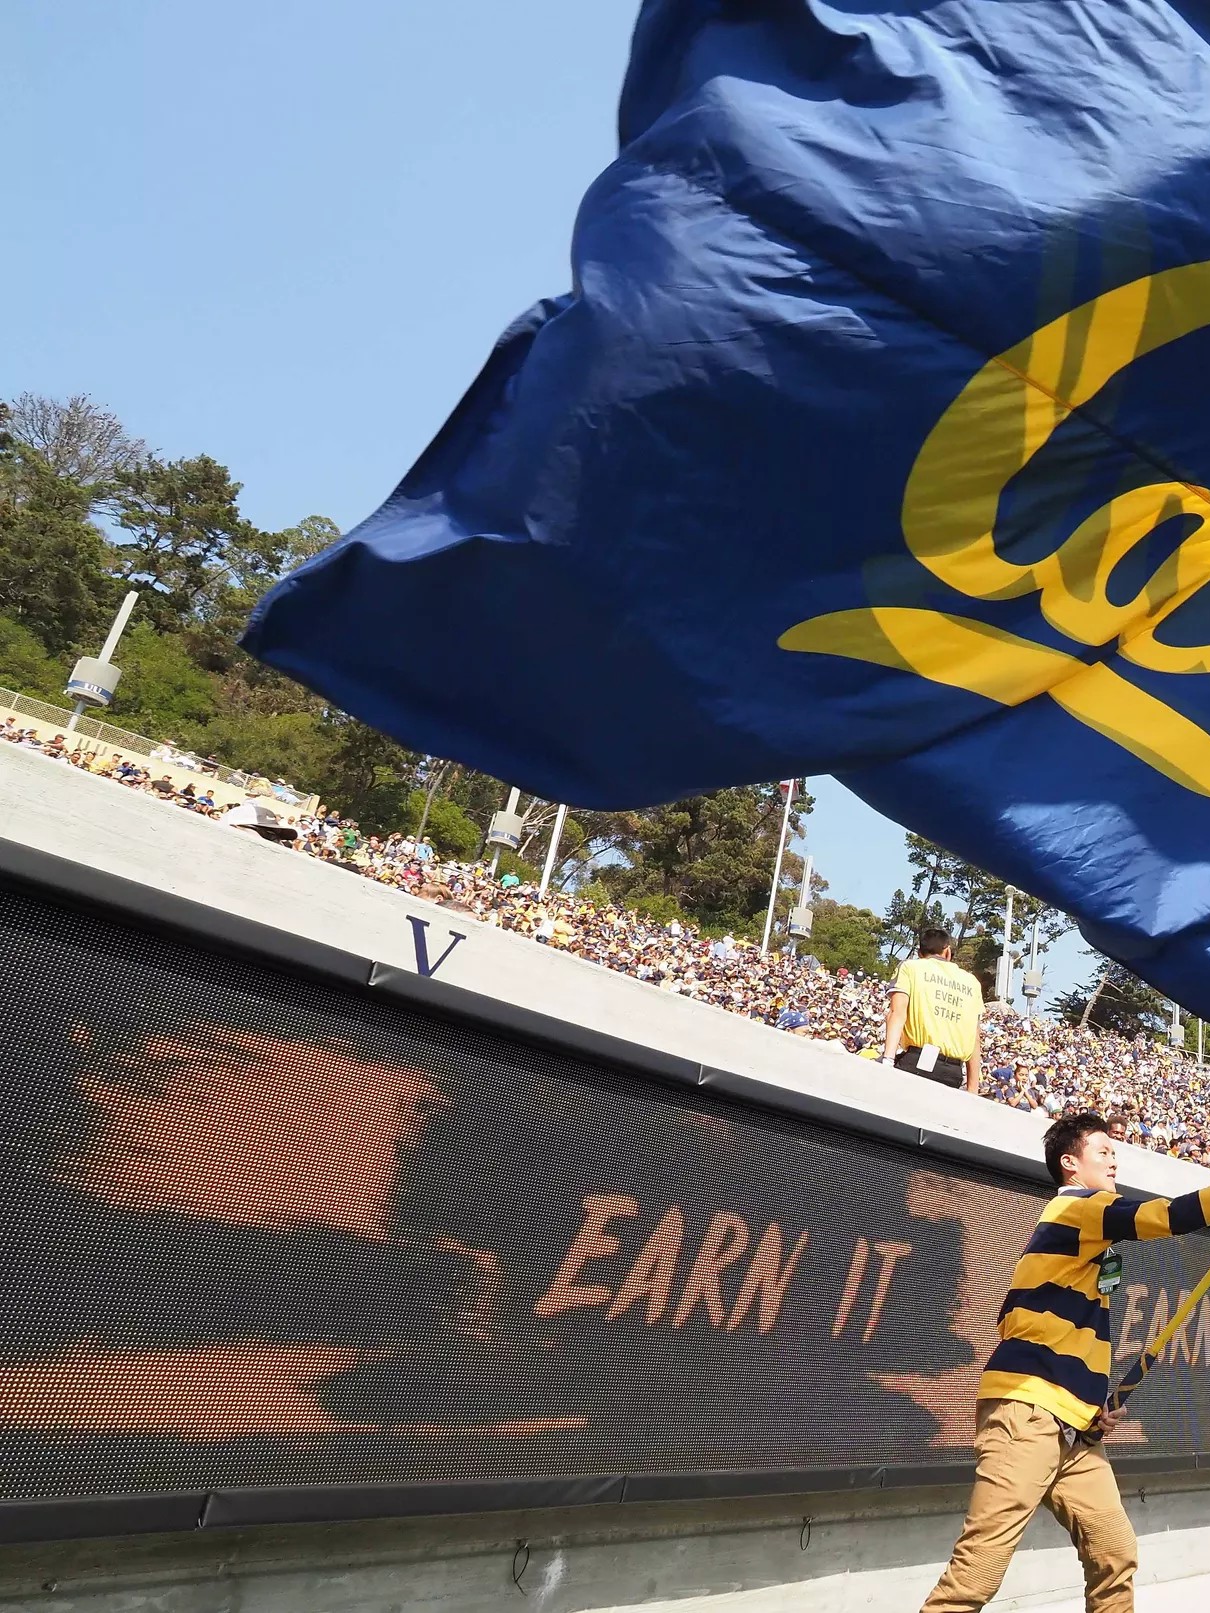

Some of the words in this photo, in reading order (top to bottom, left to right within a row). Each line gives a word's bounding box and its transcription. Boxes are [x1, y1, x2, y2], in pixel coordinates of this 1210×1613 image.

[406, 914, 467, 978] V
[934, 1005, 962, 1024] STAFF
[533, 1192, 810, 1335] EARN
[831, 1236, 913, 1343] IT
